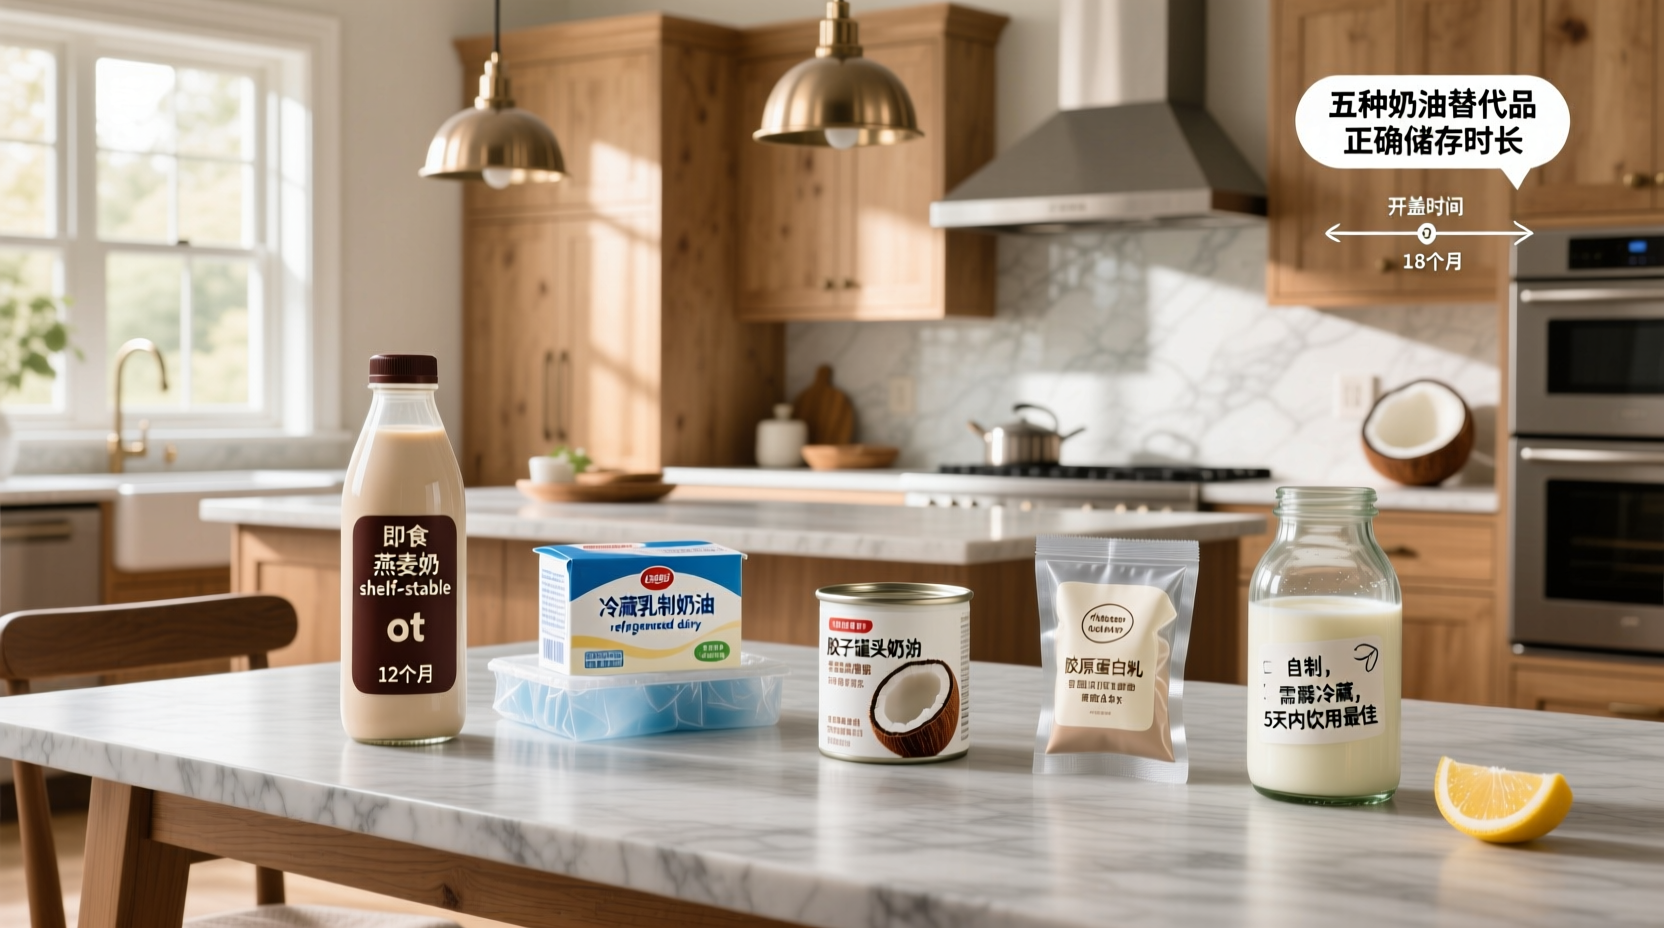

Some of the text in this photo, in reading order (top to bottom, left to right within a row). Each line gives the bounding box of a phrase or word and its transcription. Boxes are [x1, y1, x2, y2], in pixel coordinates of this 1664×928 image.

[383, 524, 429, 547] 即食
[373, 552, 439, 576] 燕麦奶
[387, 612, 425, 642] ot
[378, 664, 433, 683] 12个月
[1264, 704, 1379, 730] 5天内饮用最佳
